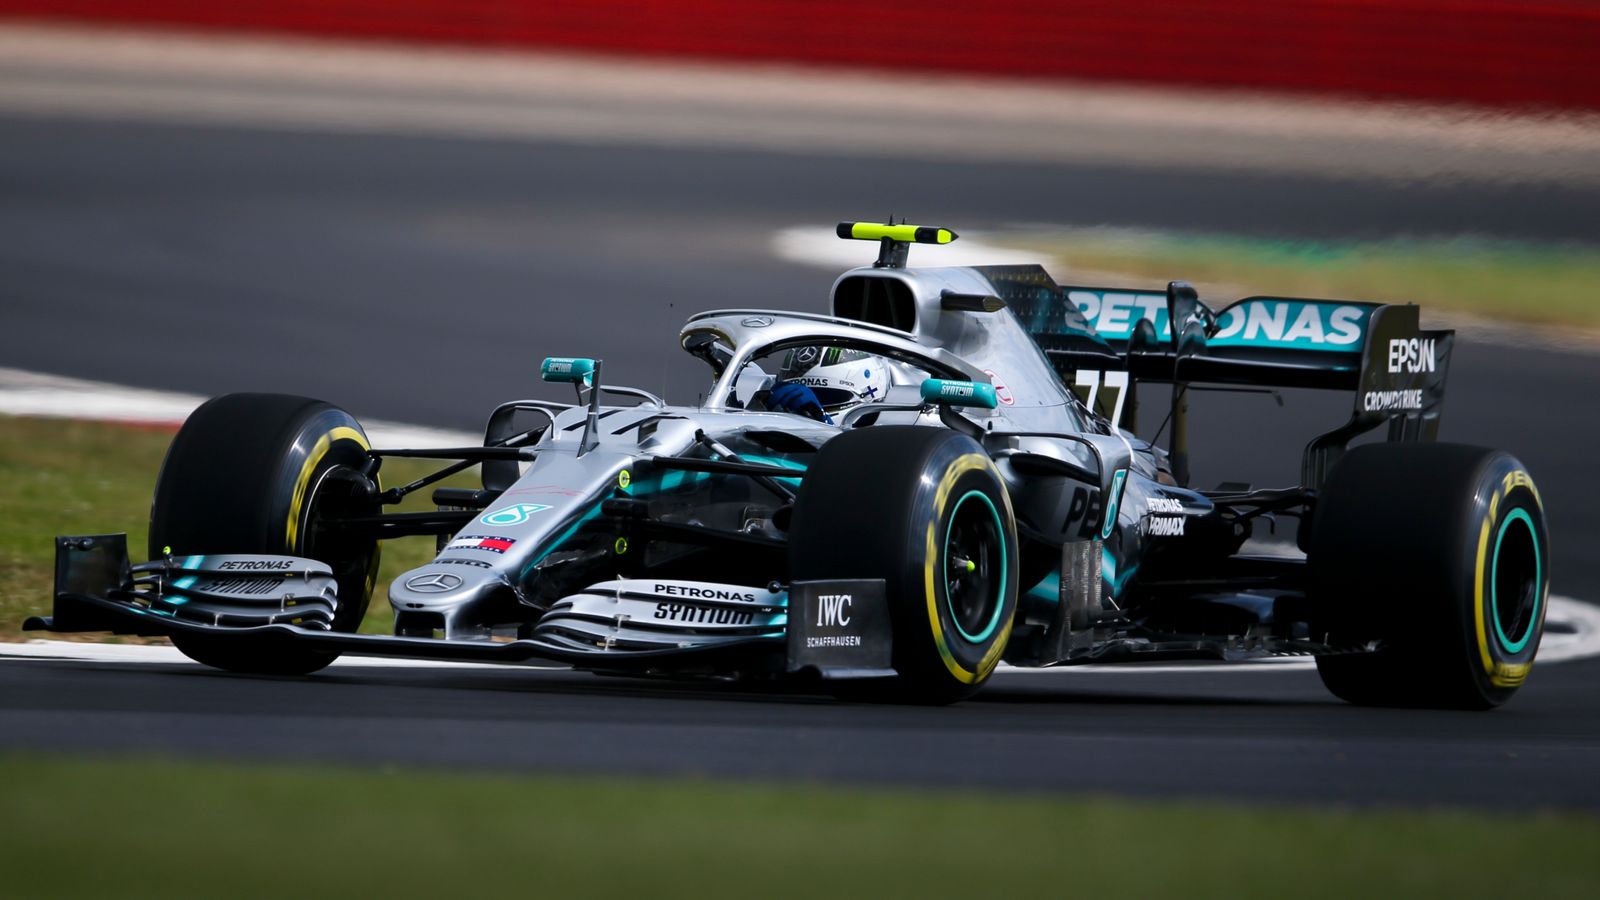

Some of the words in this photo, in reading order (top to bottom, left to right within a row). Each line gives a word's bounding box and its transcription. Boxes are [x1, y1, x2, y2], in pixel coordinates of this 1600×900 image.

[1066, 291, 1364, 345] PETONAS
[1076, 370, 1129, 434] 77
[218, 560, 294, 570] PETRONAS
[654, 584, 755, 602] PETRONAS
[654, 602, 754, 625] SYNTIUM
[817, 595, 852, 627] IWC
[806, 636, 861, 648] SCHAFFHAUSEN
